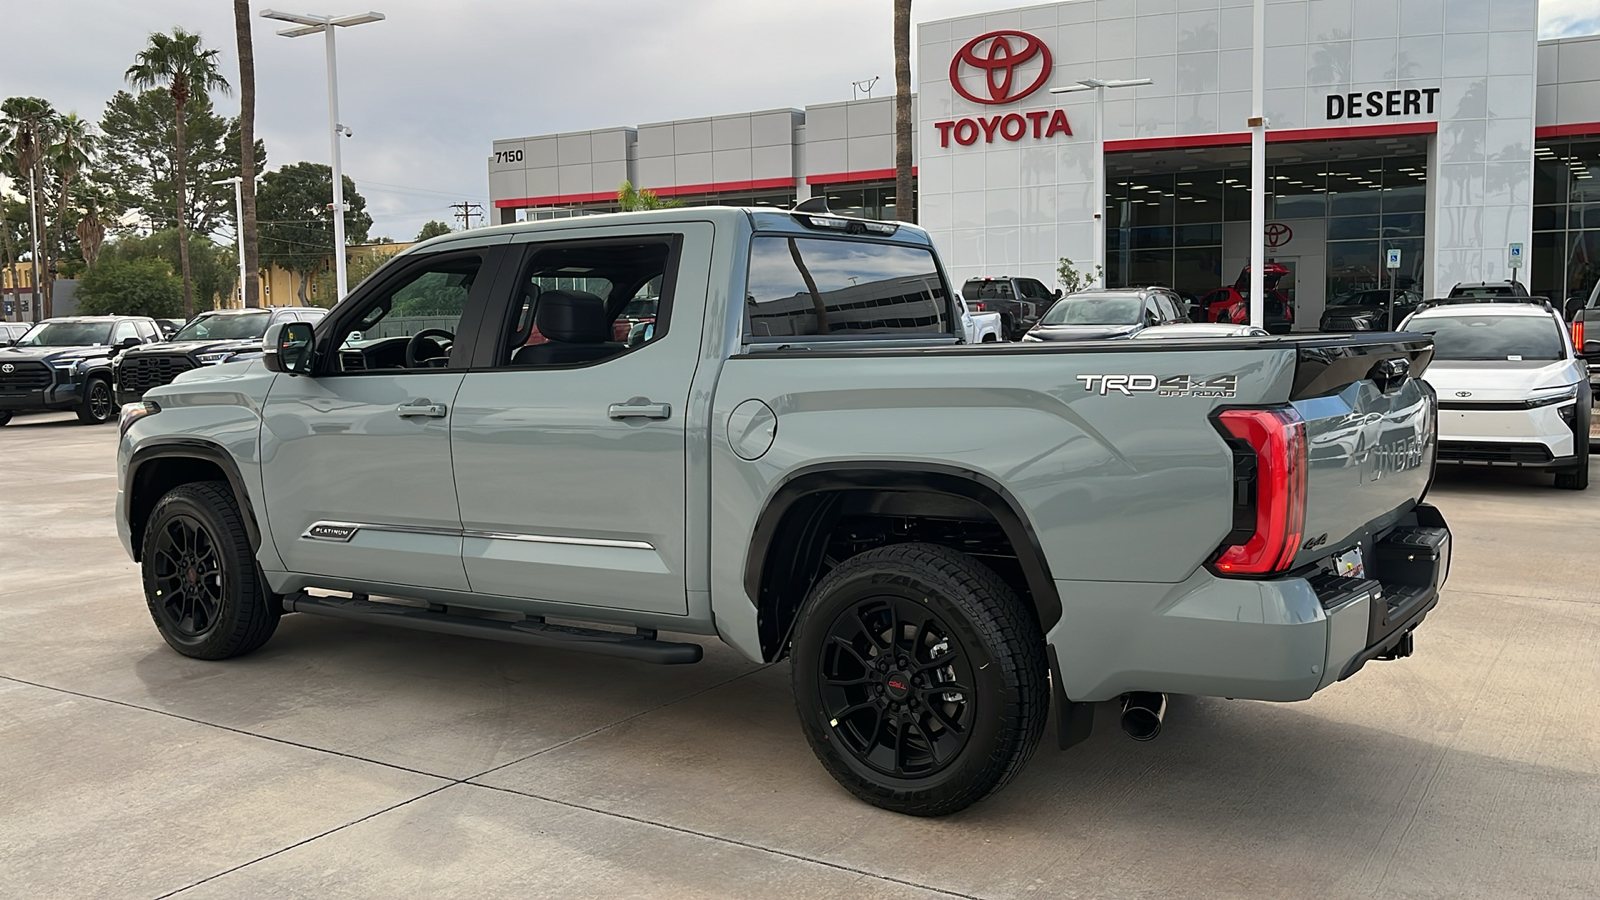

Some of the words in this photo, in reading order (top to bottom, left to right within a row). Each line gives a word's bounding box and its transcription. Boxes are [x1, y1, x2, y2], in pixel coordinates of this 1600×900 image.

[1326, 88, 1441, 120] DESERT
[935, 109, 1073, 148] TOYOTA
[496, 150, 522, 163] 7150
[1076, 374, 1158, 397] TRD
[315, 527, 348, 536] PLATINUM
